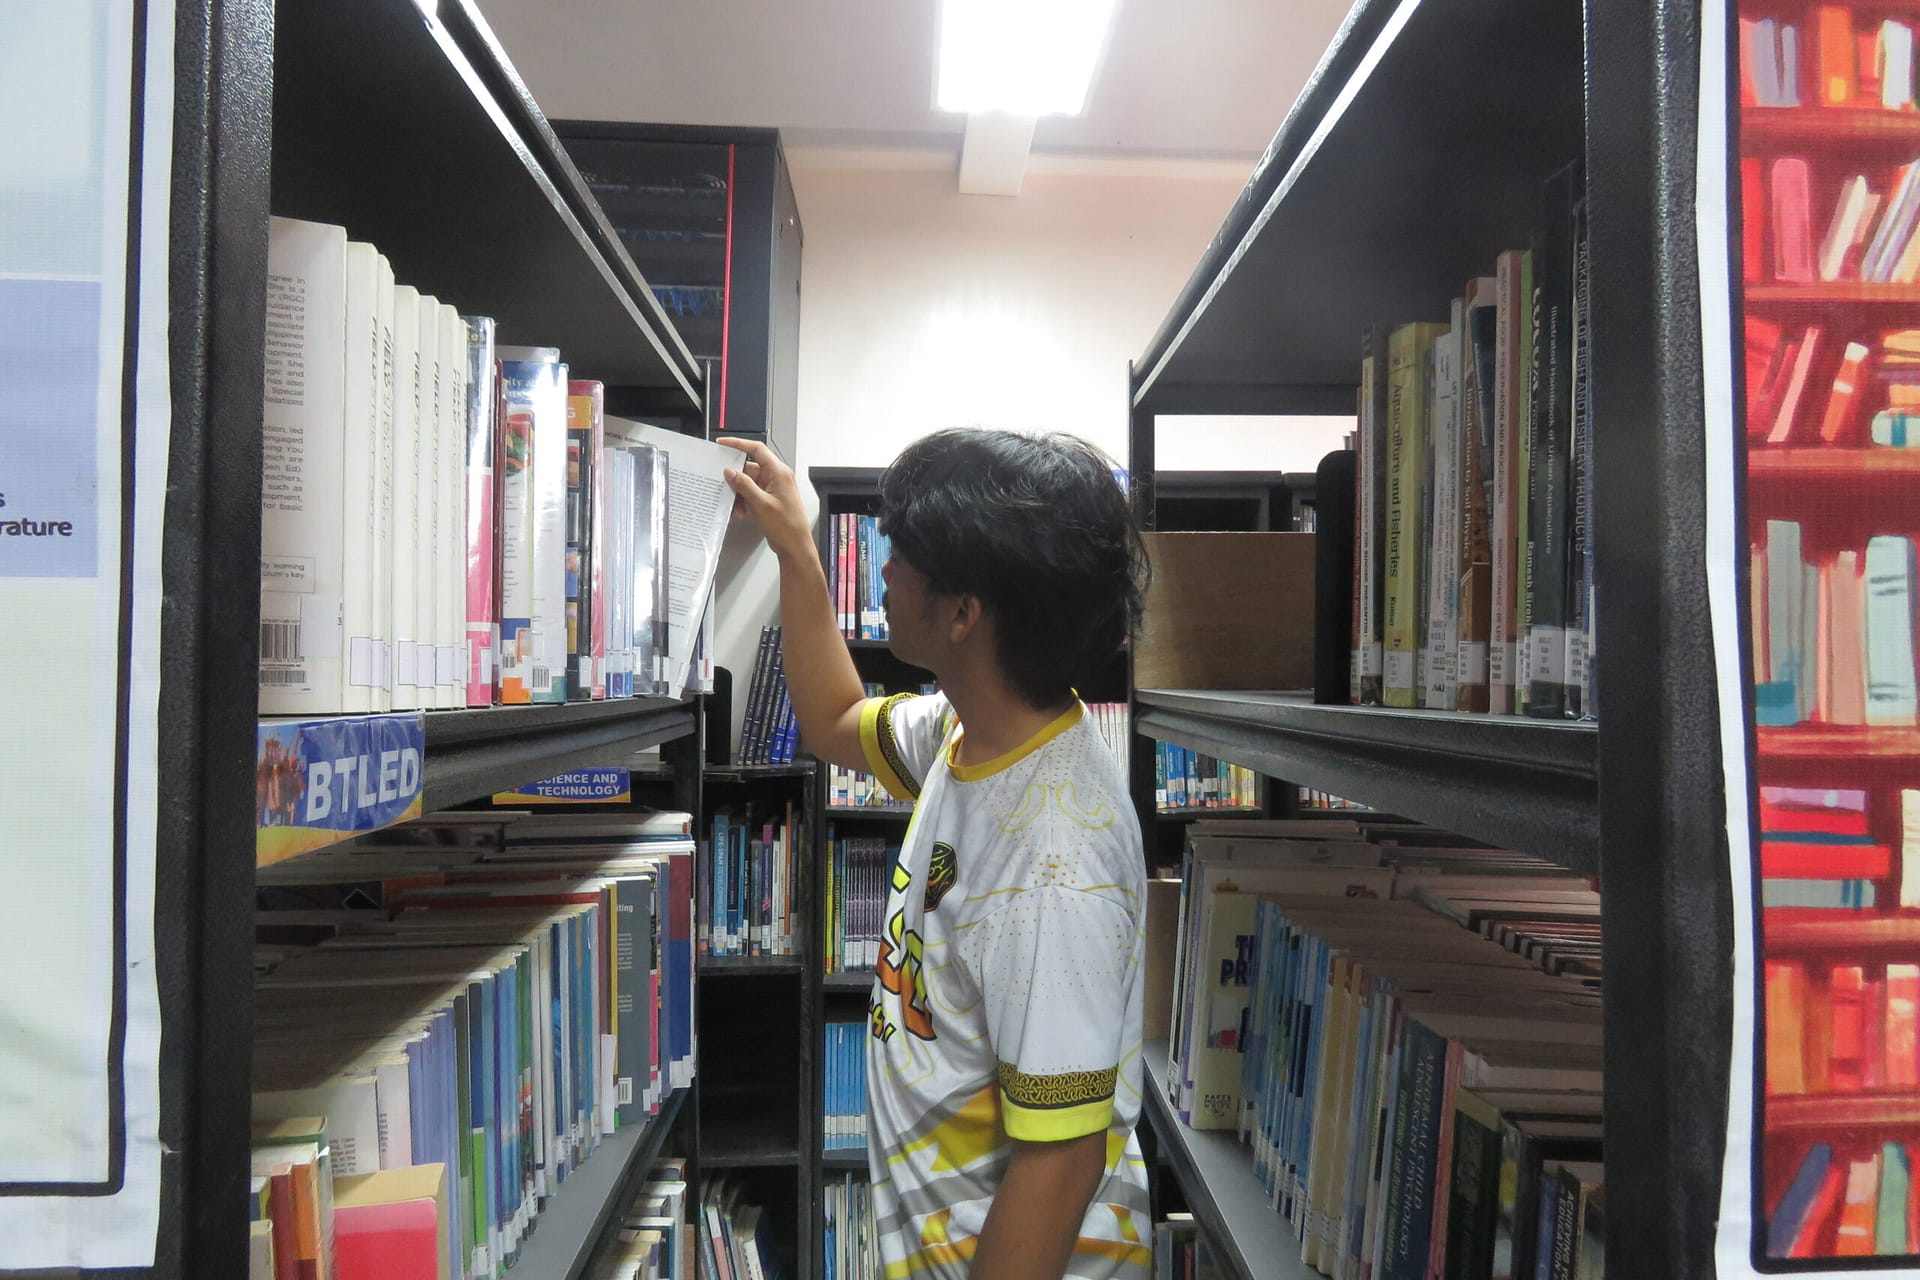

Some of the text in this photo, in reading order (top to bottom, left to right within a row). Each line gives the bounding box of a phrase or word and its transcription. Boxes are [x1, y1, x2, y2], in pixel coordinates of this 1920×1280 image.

[1575, 240, 1587, 552] PACKAGING OF FISH AND FISHERY PRODUCTS
[1390, 384, 1403, 577] Aquaculture and Fisheries
[1463, 387, 1473, 559] Introduction to Soil Physics
[1547, 445, 1555, 480] Urban
[0, 517, 73, 536] rature
[1545, 484, 1554, 554] Aquaculture
[1526, 541, 1535, 589] Ramesh
[1388, 596, 1398, 627] Kumar
[306, 747, 420, 822] BTLED
[537, 785, 621, 796] TECHNOLOGY
[592, 774, 618, 784] AND
[1399, 1057, 1423, 1262] ADOLESCENT PSYCHOLOGY
[1414, 1049, 1434, 1210] ABNORMAL CHILD
[1554, 1198, 1566, 1271] EDUCATION
[1562, 1190, 1575, 1264] ACHIEVING
